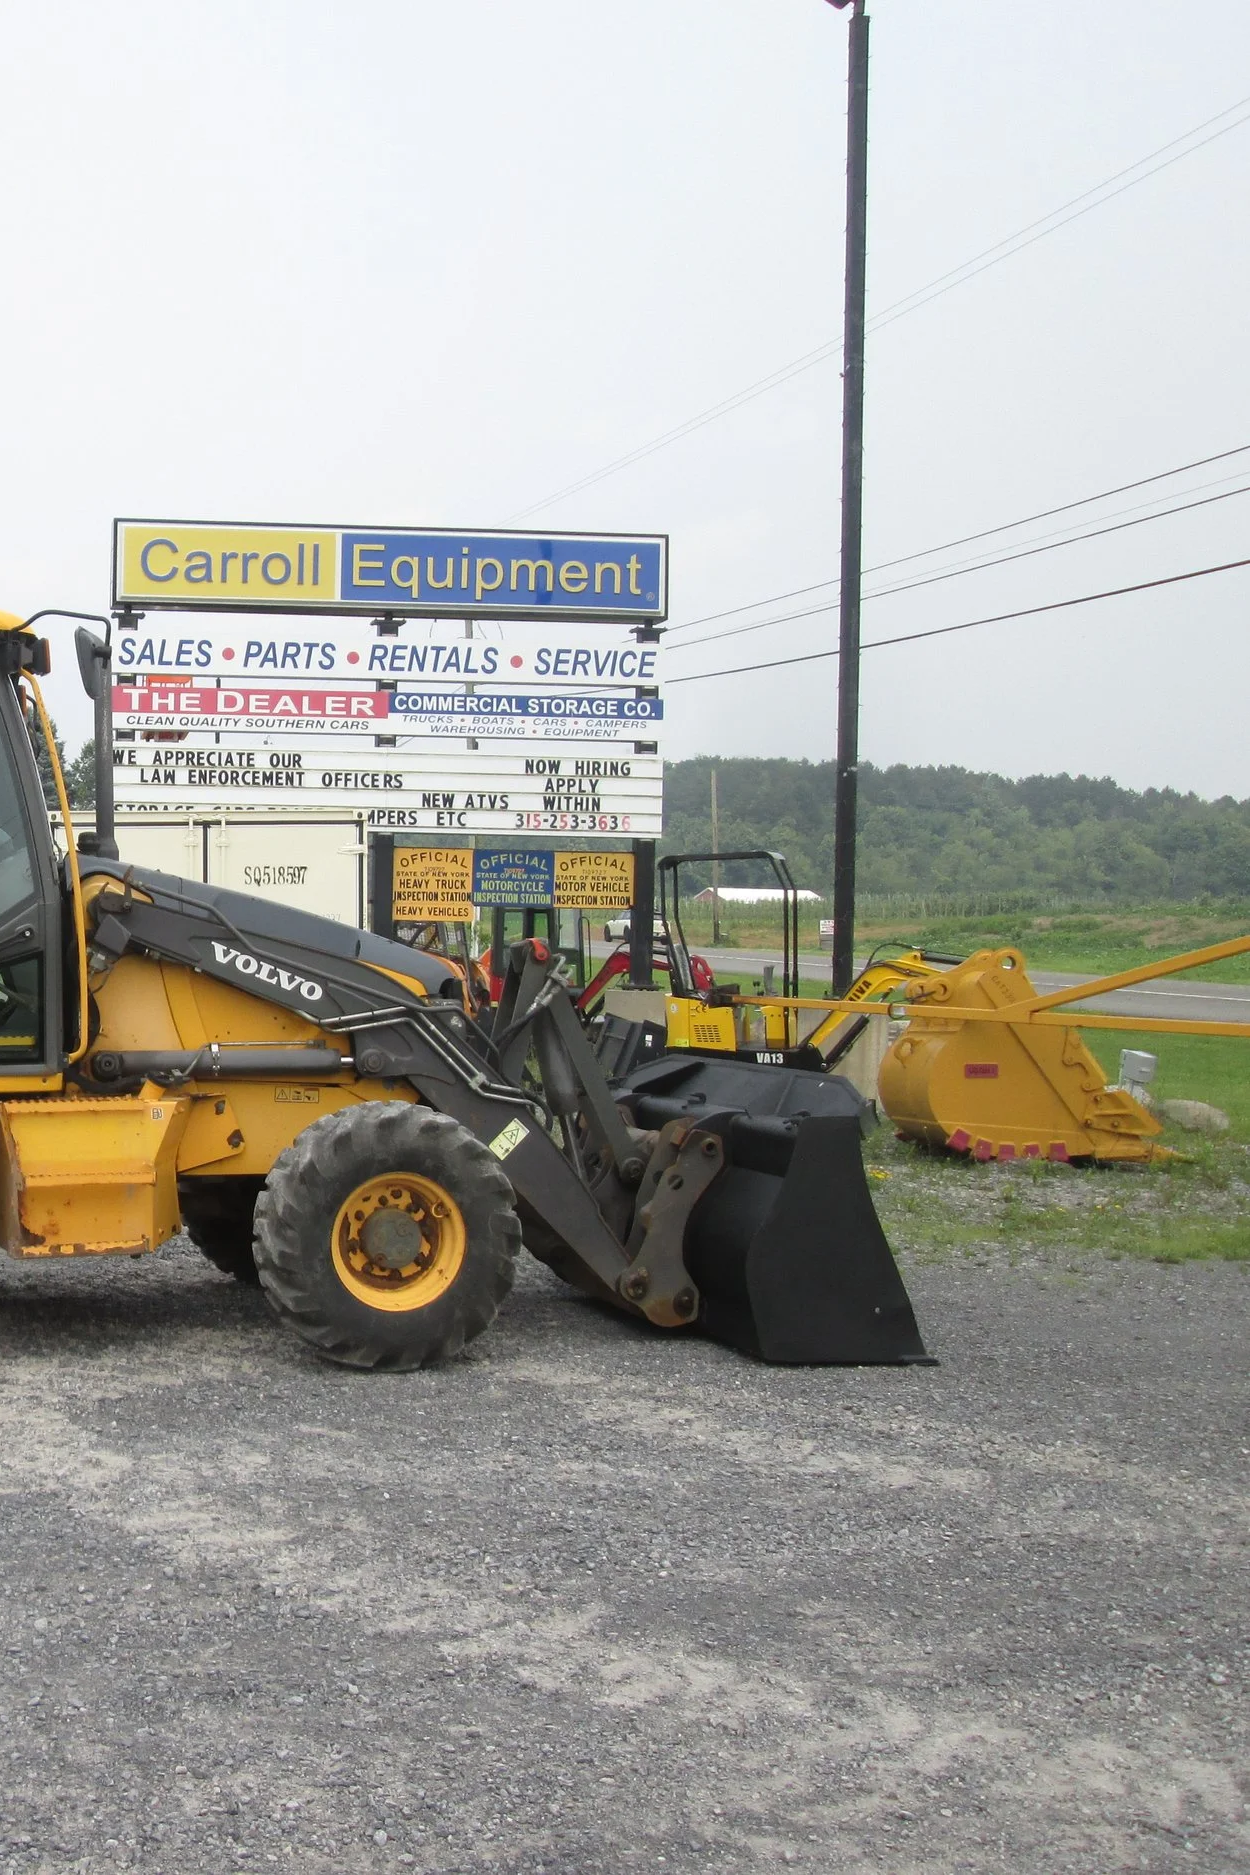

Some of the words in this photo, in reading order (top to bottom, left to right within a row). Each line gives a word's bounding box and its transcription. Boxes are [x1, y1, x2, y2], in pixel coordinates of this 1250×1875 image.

[141, 538, 319, 585] Carroll
[353, 543, 642, 600] Equipment
[118, 638, 213, 667] SALES
[243, 641, 336, 670] PARTS
[368, 644, 499, 674] RENTALS
[534, 648, 657, 678] SERVICE
[123, 688, 201, 712] THE
[217, 691, 375, 716] DEALER
[395, 695, 522, 714] COMMERCIAL
[528, 699, 618, 716] STORAGE
[624, 701, 656, 717] CO.
[127, 715, 175, 726] CLEAN
[180, 717, 240, 728] QUALITY
[246, 718, 325, 729] SOUTHERN
[331, 720, 370, 730] CARS
[402, 714, 454, 724] TRUCKS
[472, 716, 514, 725] BOATS
[533, 717, 567, 726] CARS
[586, 719, 647, 729] CAMPERS
[431, 725, 525, 735] WAREHOUSING
[544, 728, 619, 737] EQUIPMENT
[113, 750, 137, 765] WE
[153, 750, 255, 767] APPRECIATE
[269, 753, 302, 768] OUR
[525, 759, 560, 775] NOW
[575, 760, 631, 776] HIRING
[140, 768, 175, 784] LAW
[188, 769, 305, 786] ENFORCEMENT
[321, 772, 403, 789] OFFICERS
[545, 778, 599, 793] APPLY
[422, 793, 454, 808] NEW
[465, 794, 509, 810] ATVS
[543, 796, 601, 811] WITHIN
[367, 810, 418, 825] MPERS
[437, 811, 467, 827] ETC
[516, 813, 631, 830] 315-253-3636
[400, 851, 468, 868] OFFICIAL
[480, 853, 548, 871] OFFICIAL
[559, 855, 627, 872] OFFICIAL
[244, 866, 307, 886] SQ518597
[399, 879, 430, 889] HEAVY
[435, 879, 466, 889] TRUCK
[481, 880, 544, 892] MOTORCYCLE
[555, 881, 586, 892] MOTOR
[590, 882, 630, 892] VEHICLE
[394, 891, 438, 901] INSPECTION
[440, 892, 471, 901] STATION
[473, 892, 518, 903] INSPECTION
[520, 893, 551, 904] STATION
[553, 894, 597, 905] INSPECTION
[600, 895, 630, 905] STATION
[396, 906, 423, 915] HEAVY
[428, 907, 469, 917] VEHICLES
[211, 941, 323, 1000] VOLVO
[756, 1052, 784, 1064] VA13
